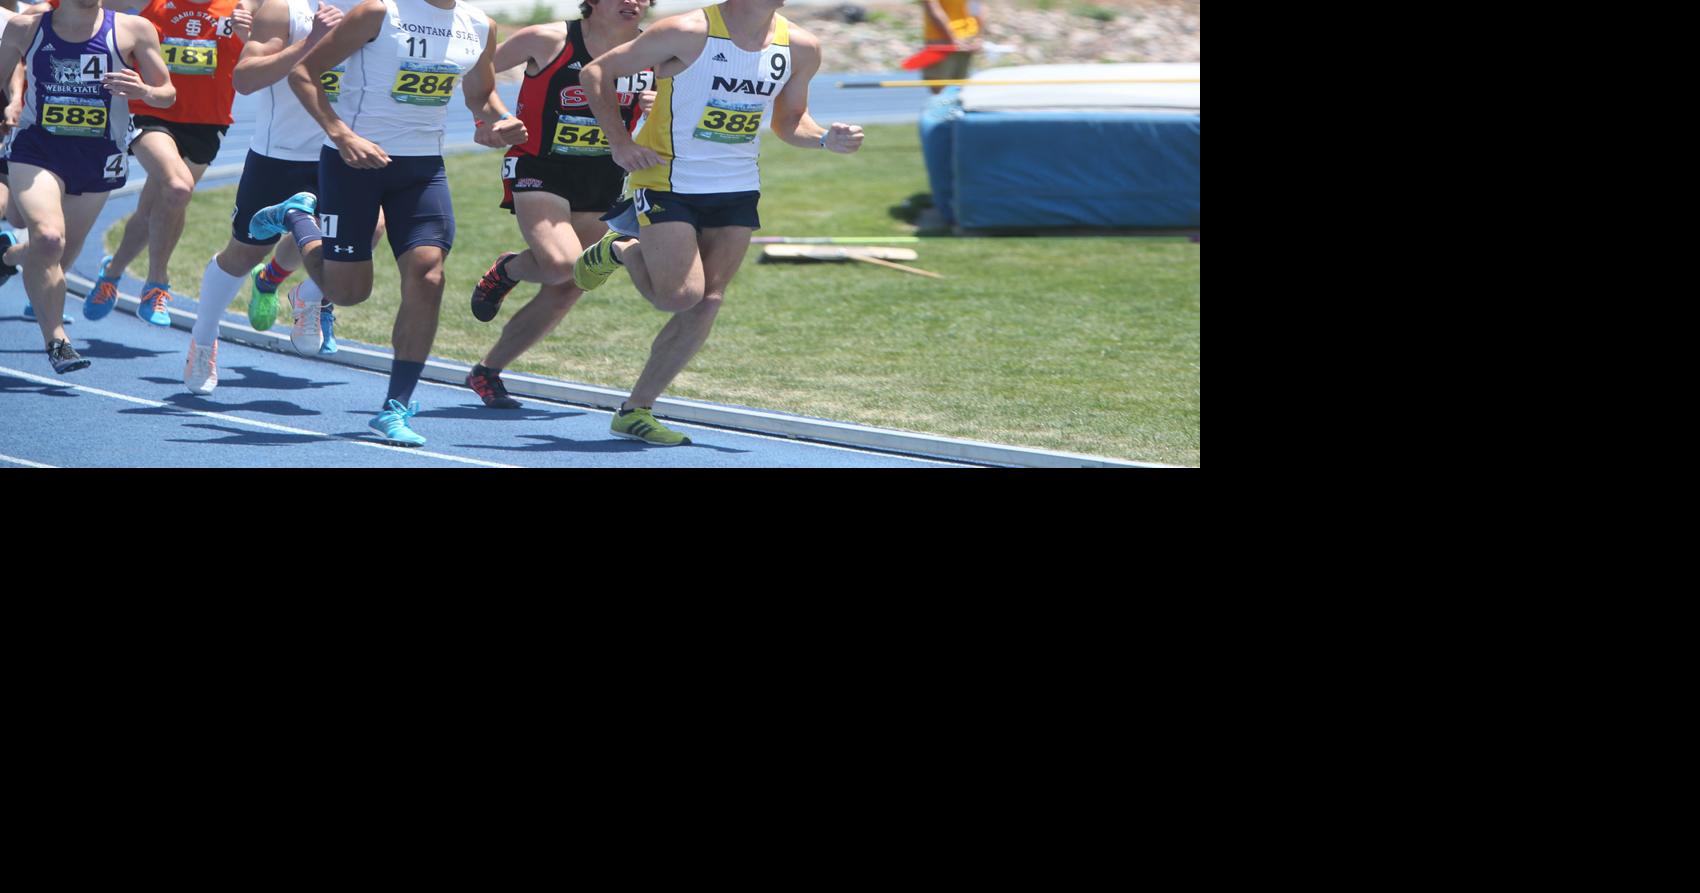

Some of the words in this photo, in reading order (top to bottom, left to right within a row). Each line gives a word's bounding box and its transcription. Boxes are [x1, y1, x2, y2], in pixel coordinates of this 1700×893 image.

[223, 19, 233, 35] 8
[397, 23, 453, 37] MONTANA
[165, 47, 213, 65] 181
[406, 37, 427, 58] 11
[82, 55, 103, 79] 4
[770, 53, 786, 80] 9
[46, 84, 72, 93] WEBER
[73, 85, 98, 94] STATE
[397, 73, 455, 94] 284
[628, 73, 648, 91] 15
[711, 75, 776, 96] NAU
[44, 106, 105, 126] 583
[703, 110, 761, 132] 385
[105, 154, 124, 176] 4
